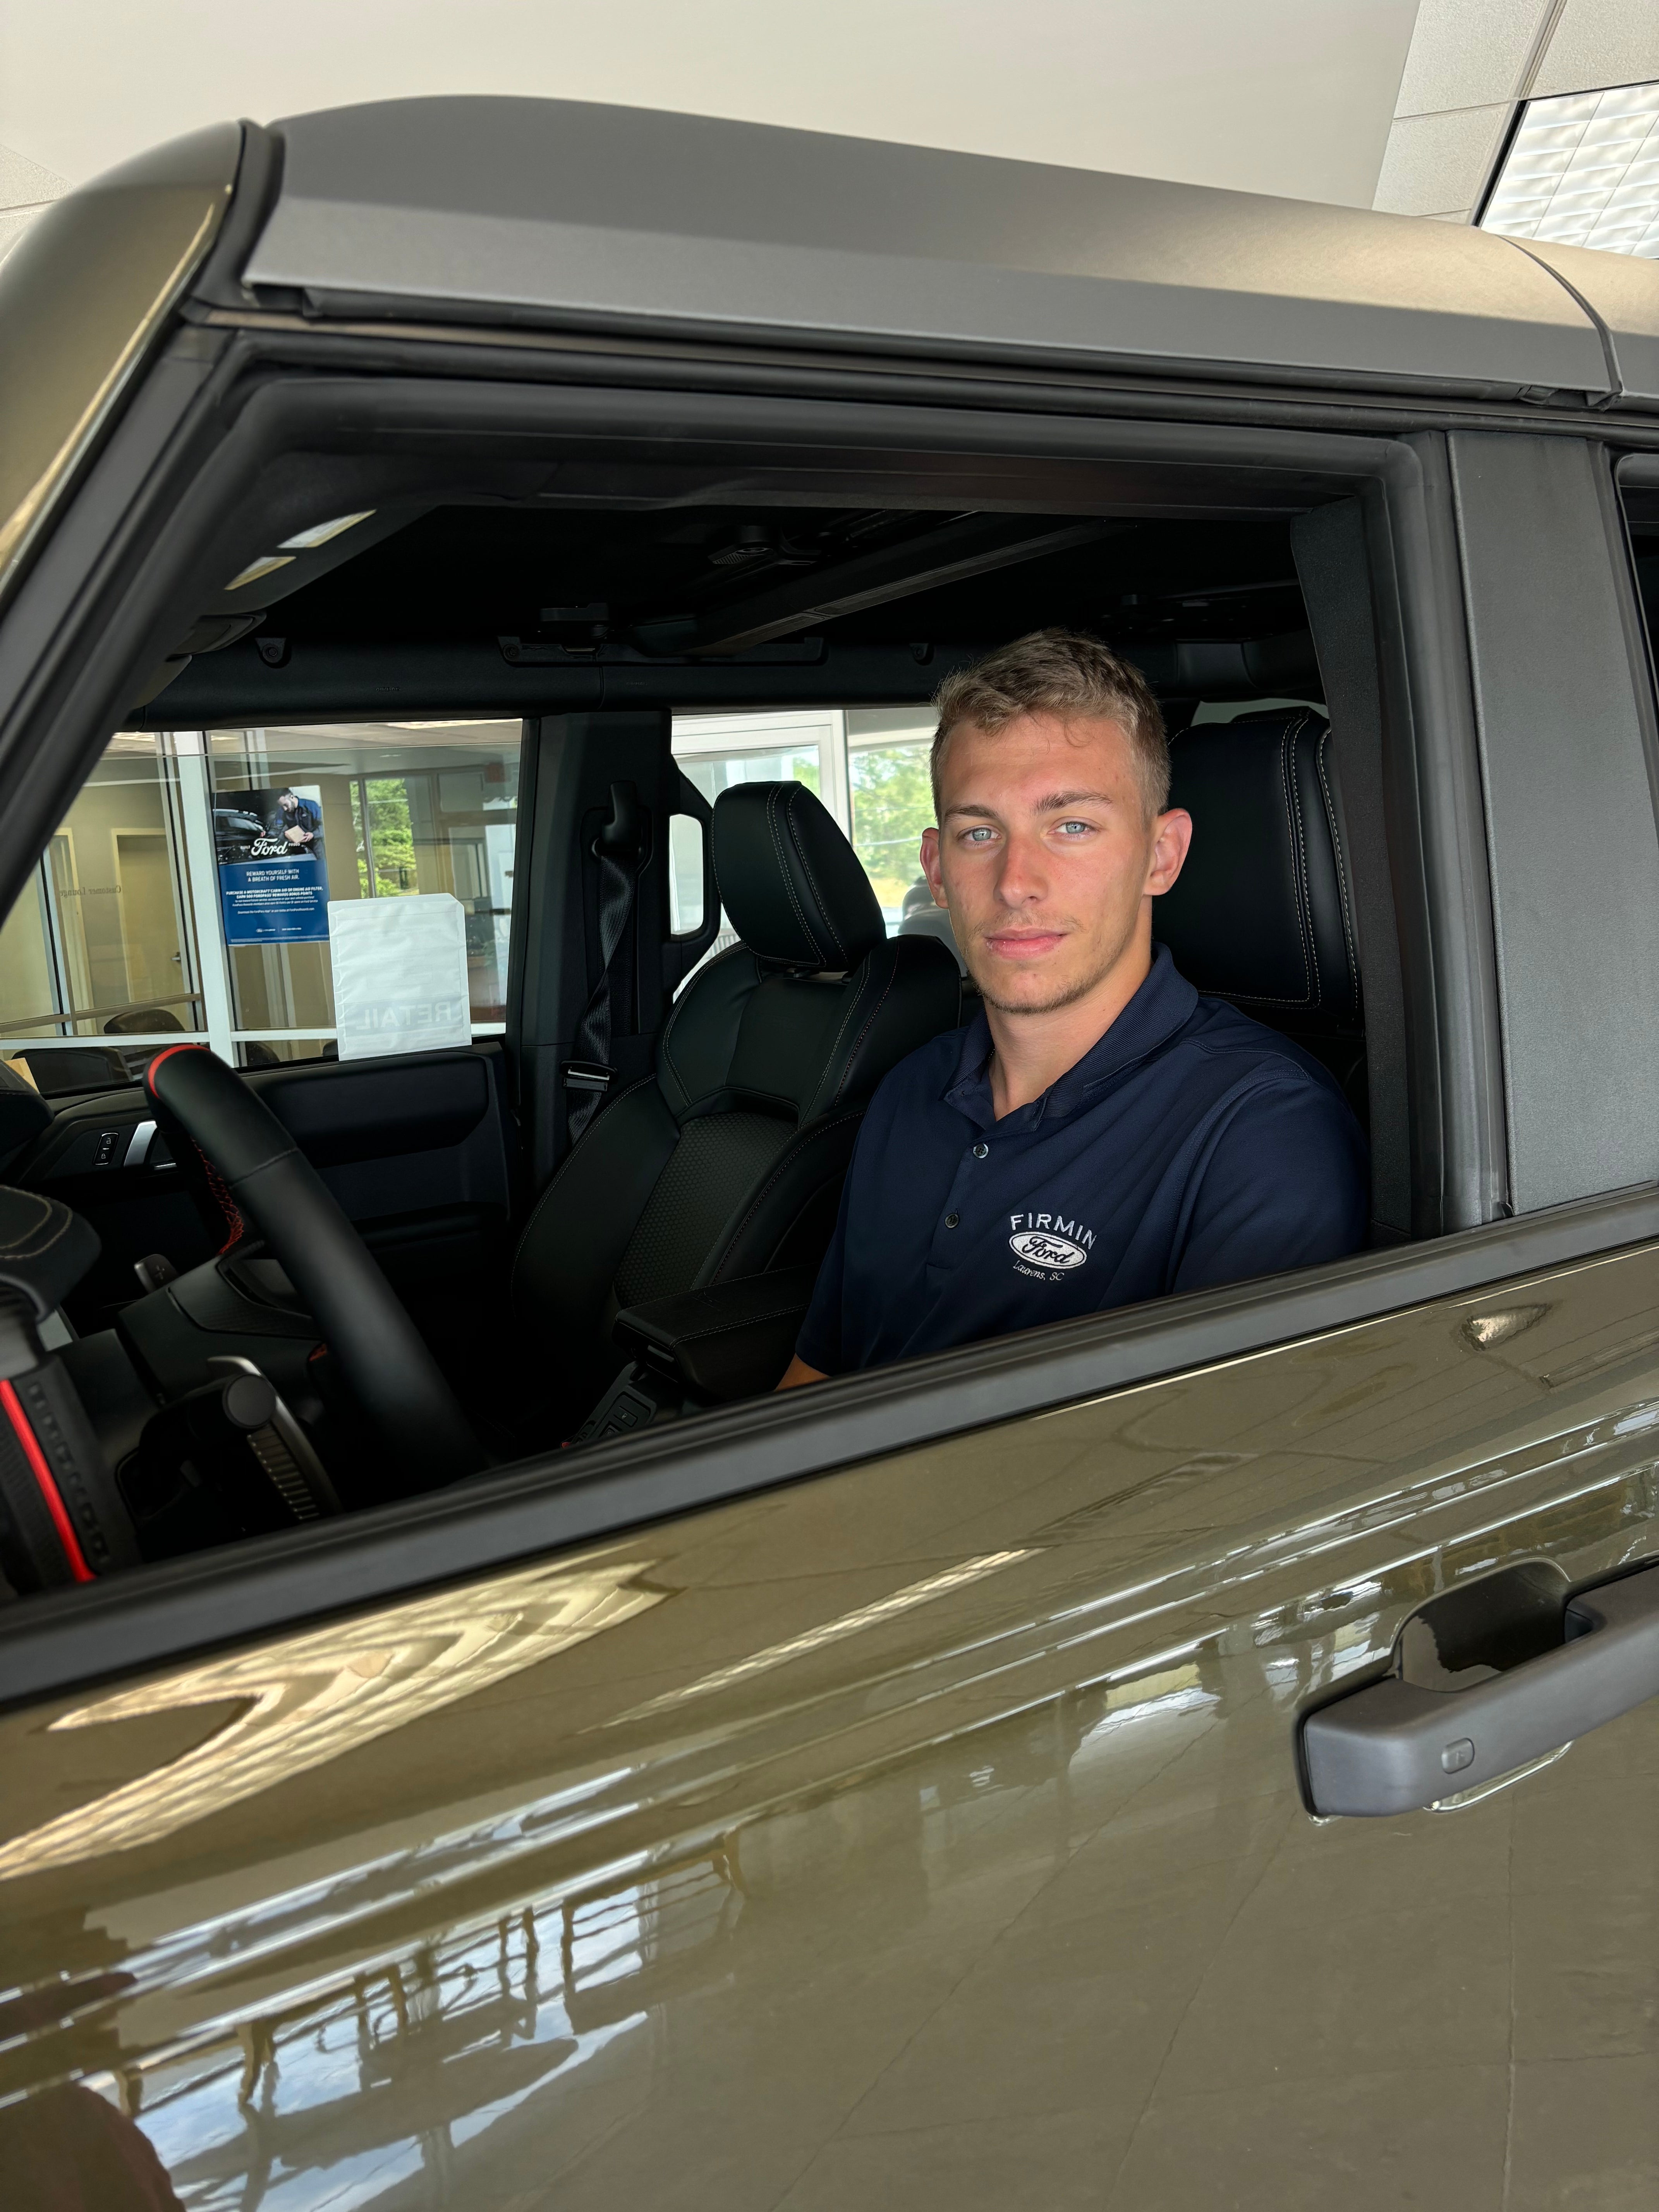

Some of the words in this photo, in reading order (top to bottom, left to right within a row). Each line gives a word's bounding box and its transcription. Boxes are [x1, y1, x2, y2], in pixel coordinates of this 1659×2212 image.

[251, 838, 288, 856] Ford
[1010, 1212, 1097, 1250] FIRMIN
[1022, 1236, 1075, 1264] Ford
[1013, 1260, 1046, 1281] Laurens,
[1049, 1272, 1065, 1281] SC
